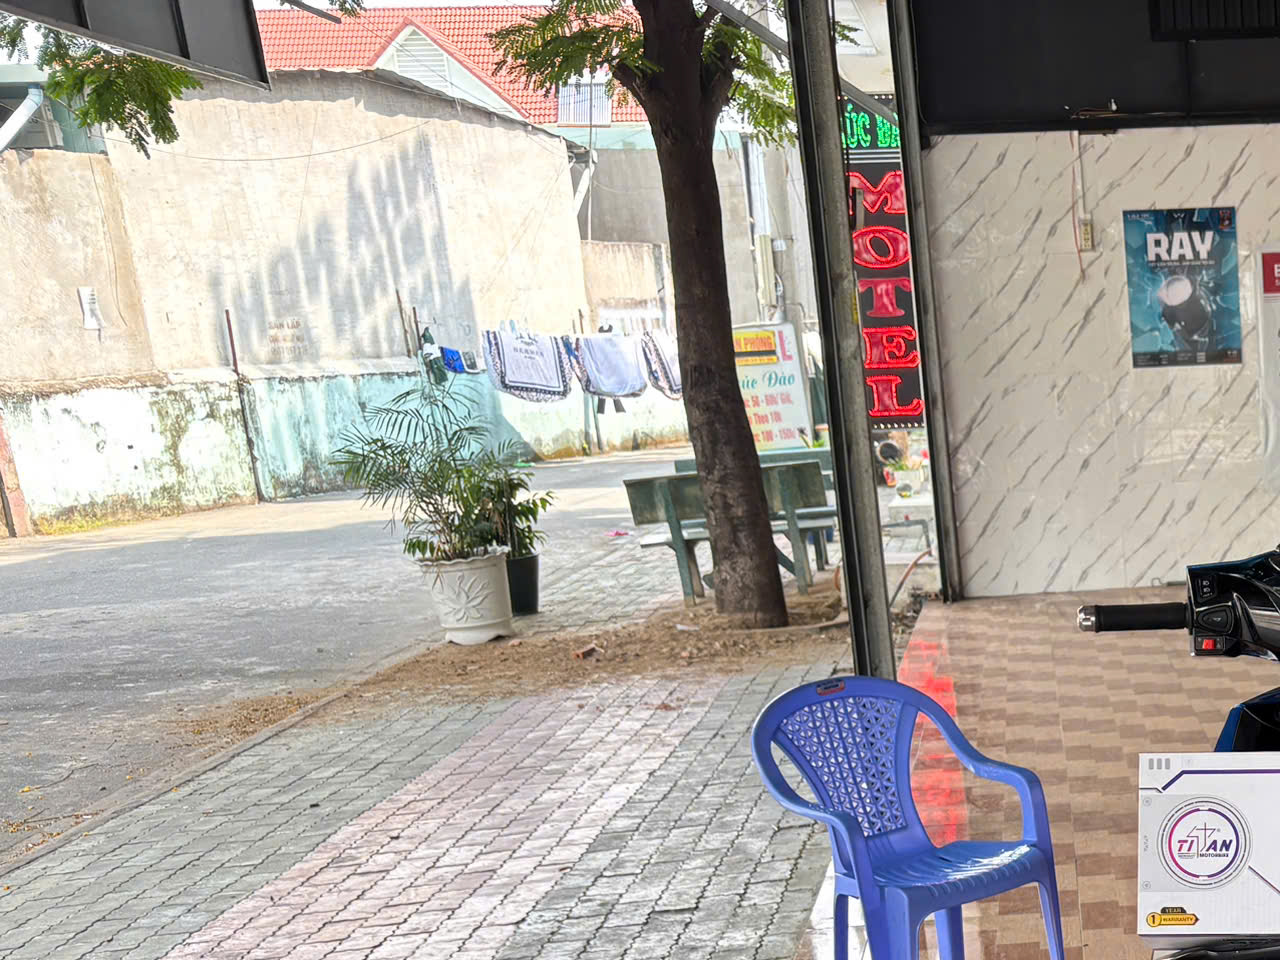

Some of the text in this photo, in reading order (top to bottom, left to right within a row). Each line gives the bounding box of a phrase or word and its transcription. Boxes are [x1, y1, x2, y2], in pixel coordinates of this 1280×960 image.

[842, 104, 871, 149] ÚC
[1146, 231, 1214, 261] RAY
[846, 170, 925, 416] MOTEL
